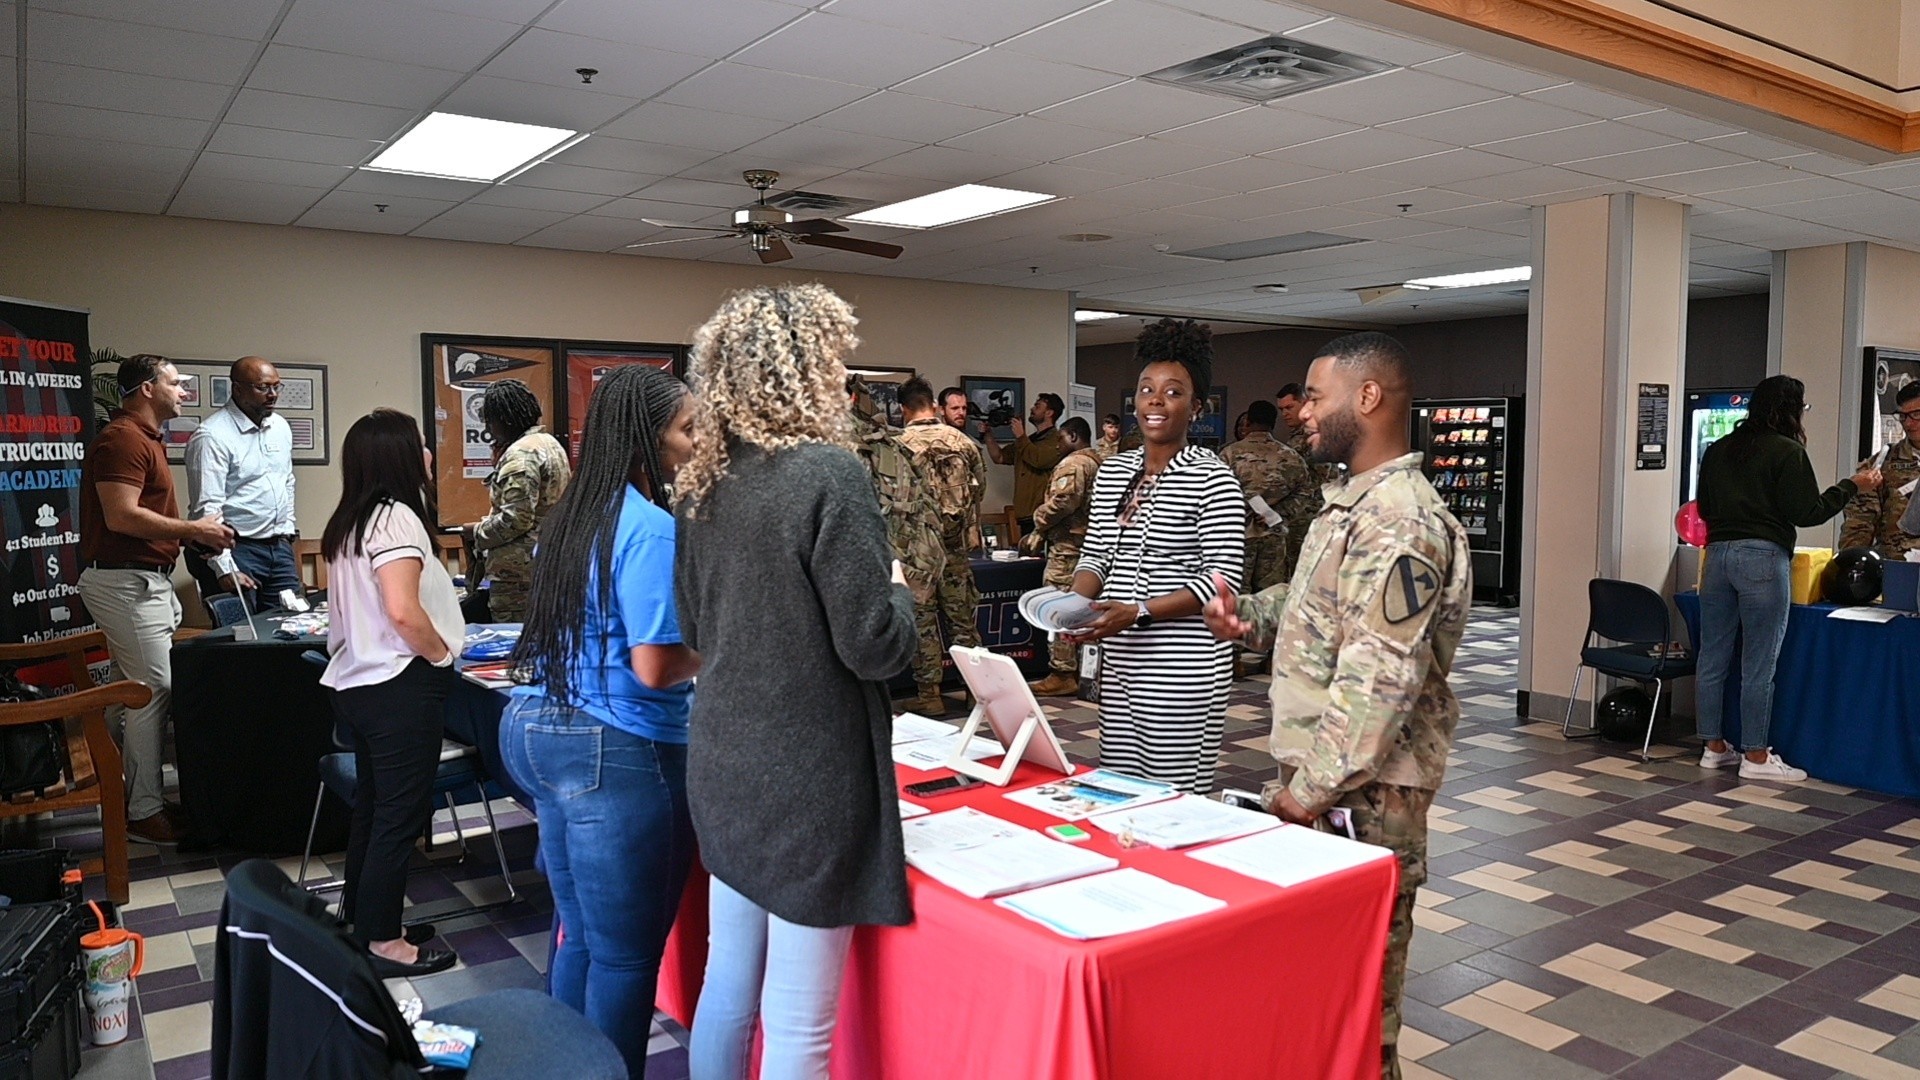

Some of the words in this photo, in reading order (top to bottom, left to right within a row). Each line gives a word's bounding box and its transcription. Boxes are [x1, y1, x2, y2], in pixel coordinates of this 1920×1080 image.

[25, 338, 77, 363] YOUR
[9, 370, 26, 386] IN
[27, 374, 35, 388] 4
[35, 372, 82, 389] WEEKS
[0, 442, 85, 461] TRUCKING
[5, 539, 20, 552] 4:1
[21, 532, 64, 549] Student
[64, 531, 80, 544] Ra
[12, 592, 26, 607] $0
[27, 588, 47, 602] Out
[48, 583, 60, 598] of
[43, 623, 97, 641] Placement
[1000, 650, 1030, 658] OARD
